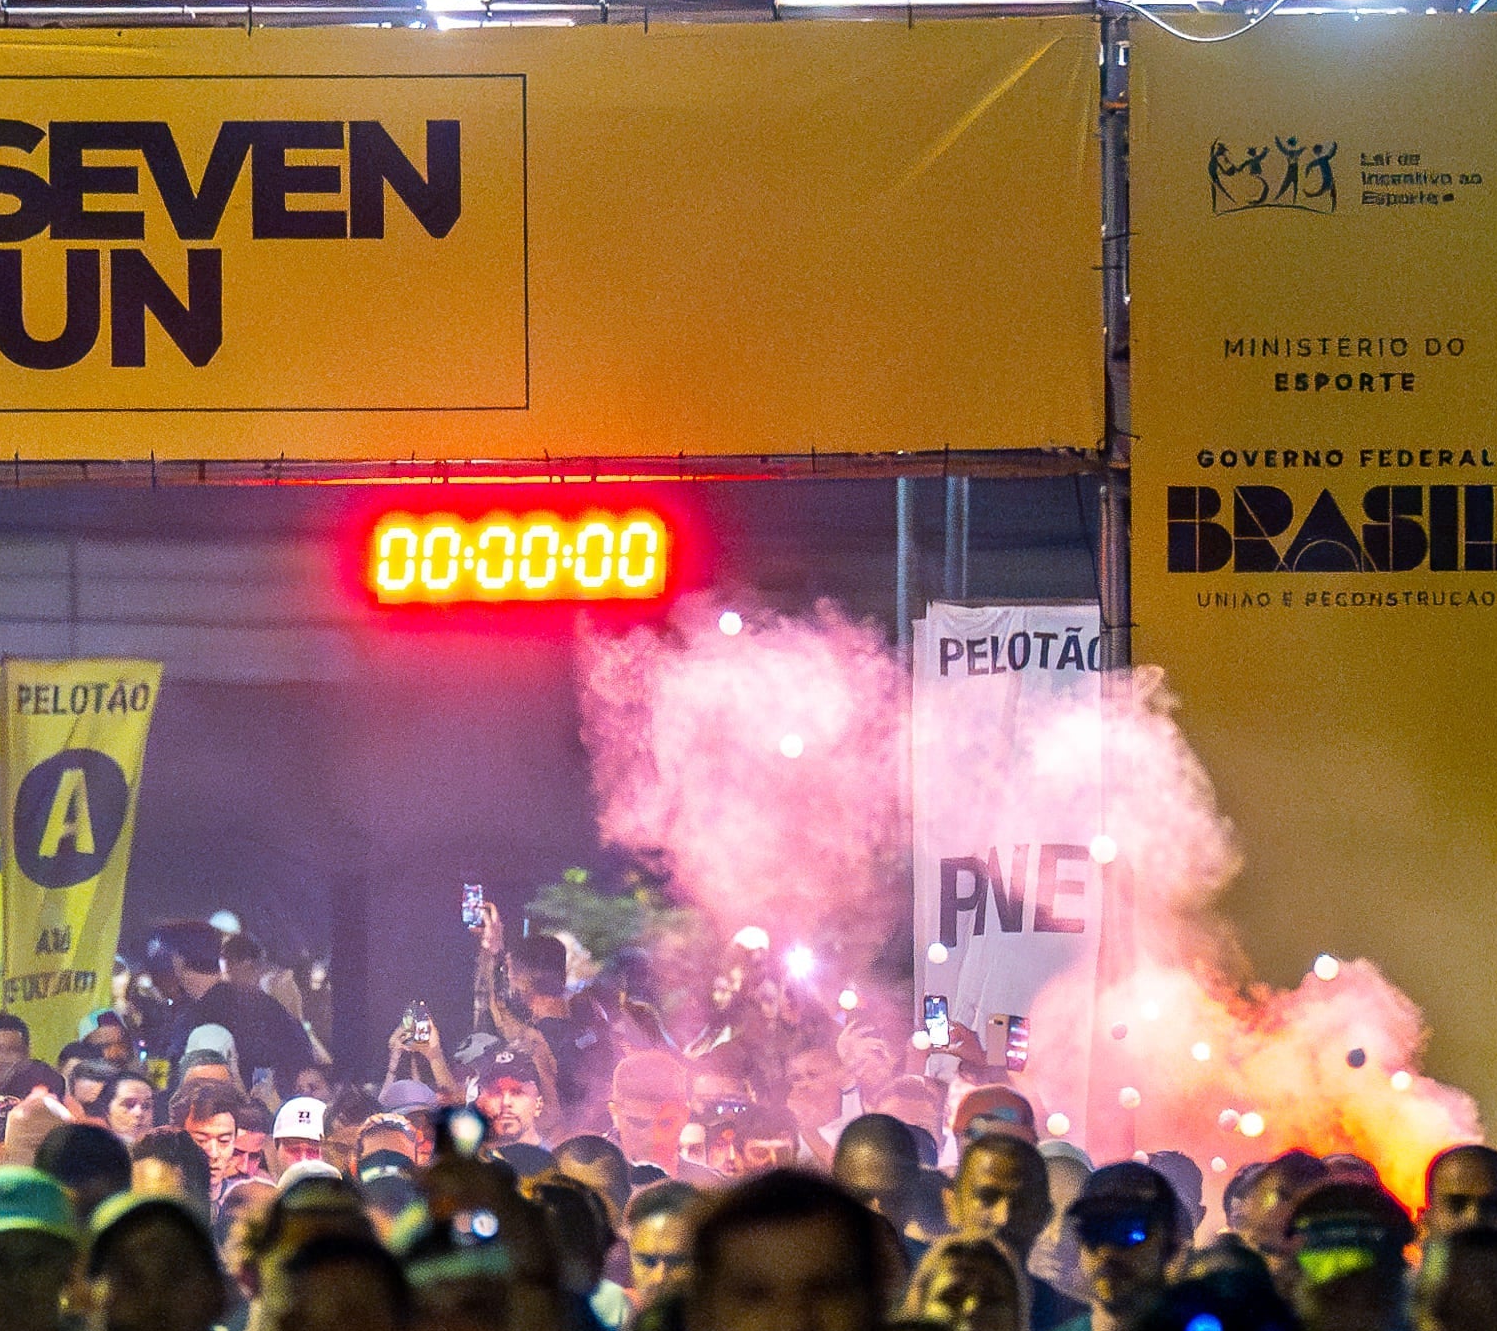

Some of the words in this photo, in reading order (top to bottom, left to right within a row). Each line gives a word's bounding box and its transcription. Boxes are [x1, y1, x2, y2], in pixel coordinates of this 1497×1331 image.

[1224, 335, 1408, 359] MINISTÉRIO
[1425, 337, 1466, 357] DO
[1275, 372, 1415, 392] ESPORTE
[1197, 449, 1344, 468] GOVERNO
[1359, 448, 1495, 468] FEDERAL
[376, 522, 657, 590] 00:00:00
[39, 768, 95, 857] A
[939, 843, 1091, 949] PNE
